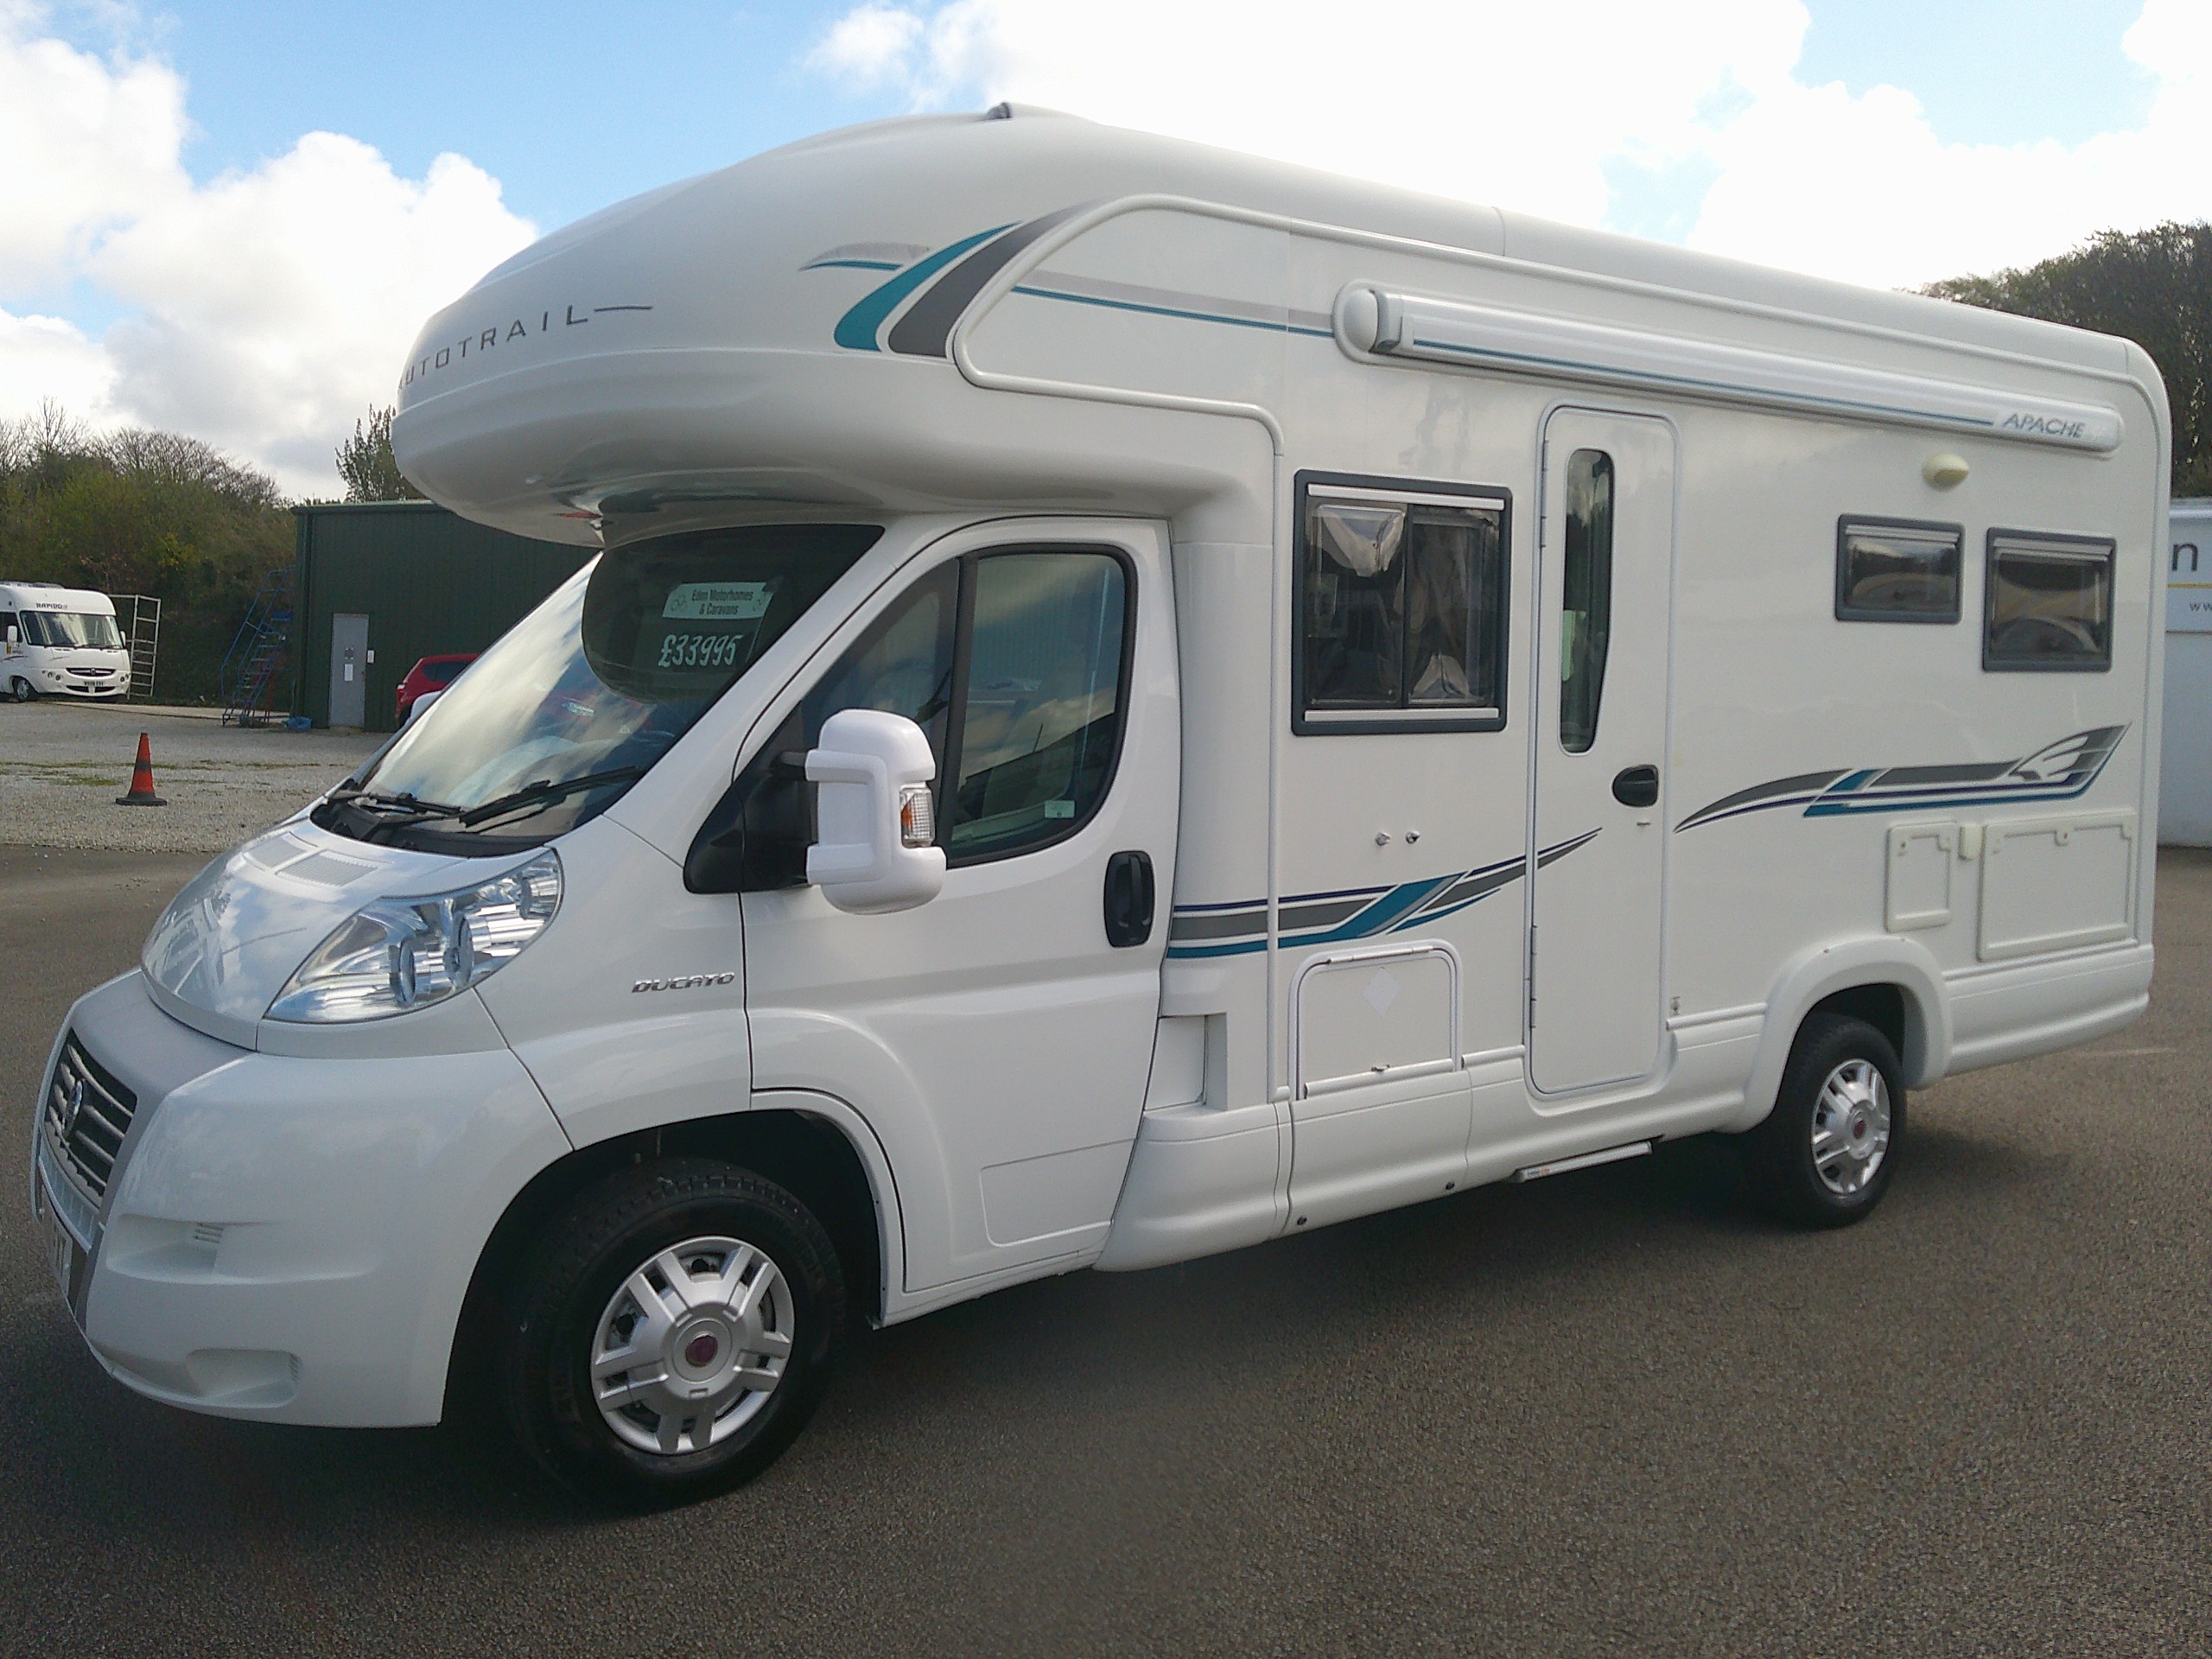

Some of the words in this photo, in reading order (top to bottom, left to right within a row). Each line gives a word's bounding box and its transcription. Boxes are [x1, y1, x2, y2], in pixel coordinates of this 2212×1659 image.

[2003, 412, 2085, 438] APACHE
[709, 588, 753, 601] Motorhomes
[707, 603, 739, 615] Caravans
[658, 634, 743, 667] £33995
[632, 971, 734, 994] DUCATO
